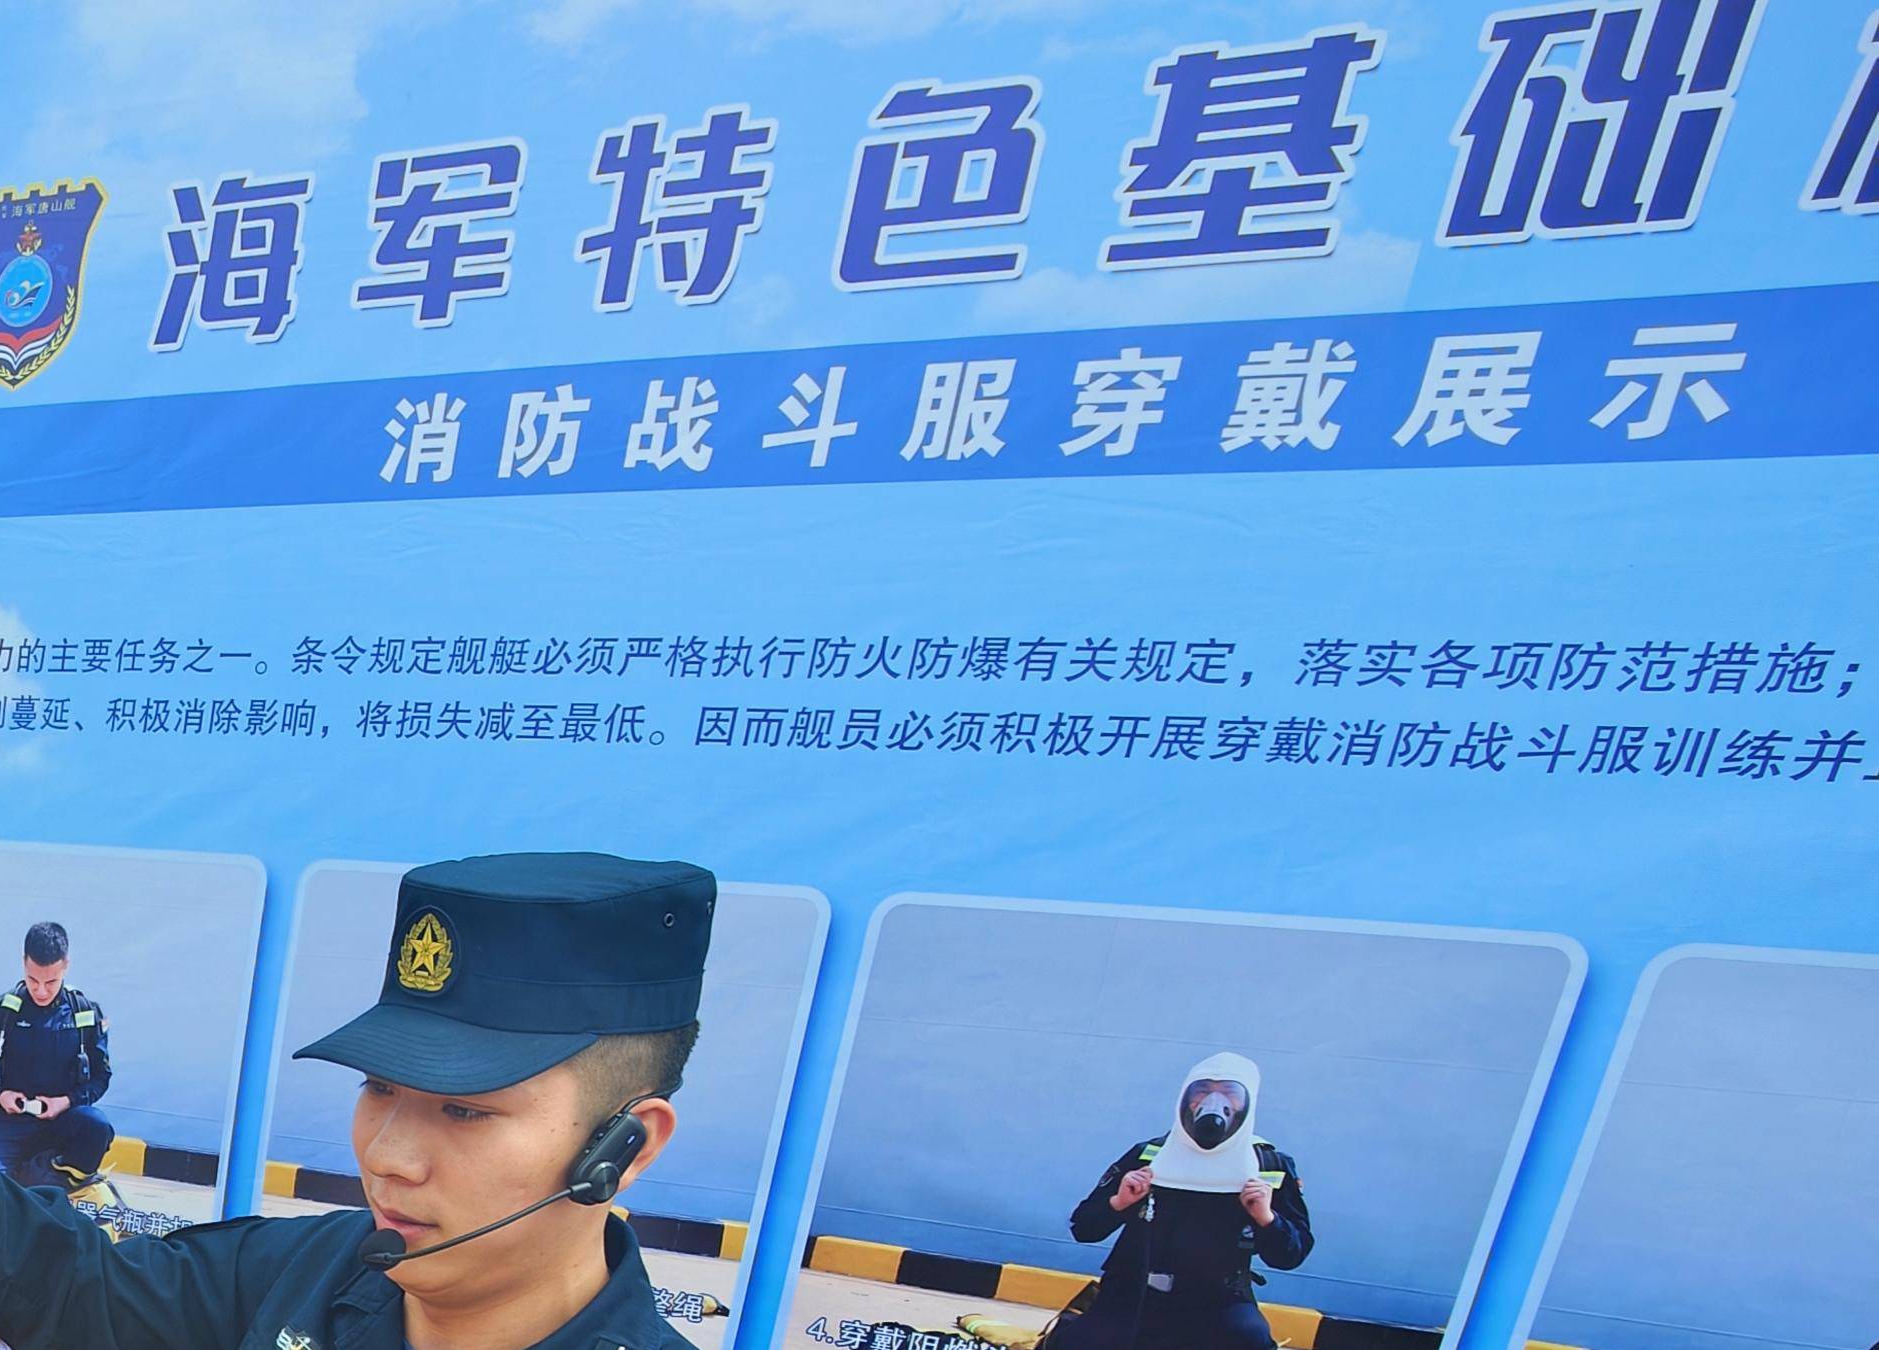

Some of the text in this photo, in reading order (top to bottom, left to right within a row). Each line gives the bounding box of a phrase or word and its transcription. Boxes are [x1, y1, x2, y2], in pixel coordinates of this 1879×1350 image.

[380, 320, 1747, 484] 消防战斗服穿戴展示
